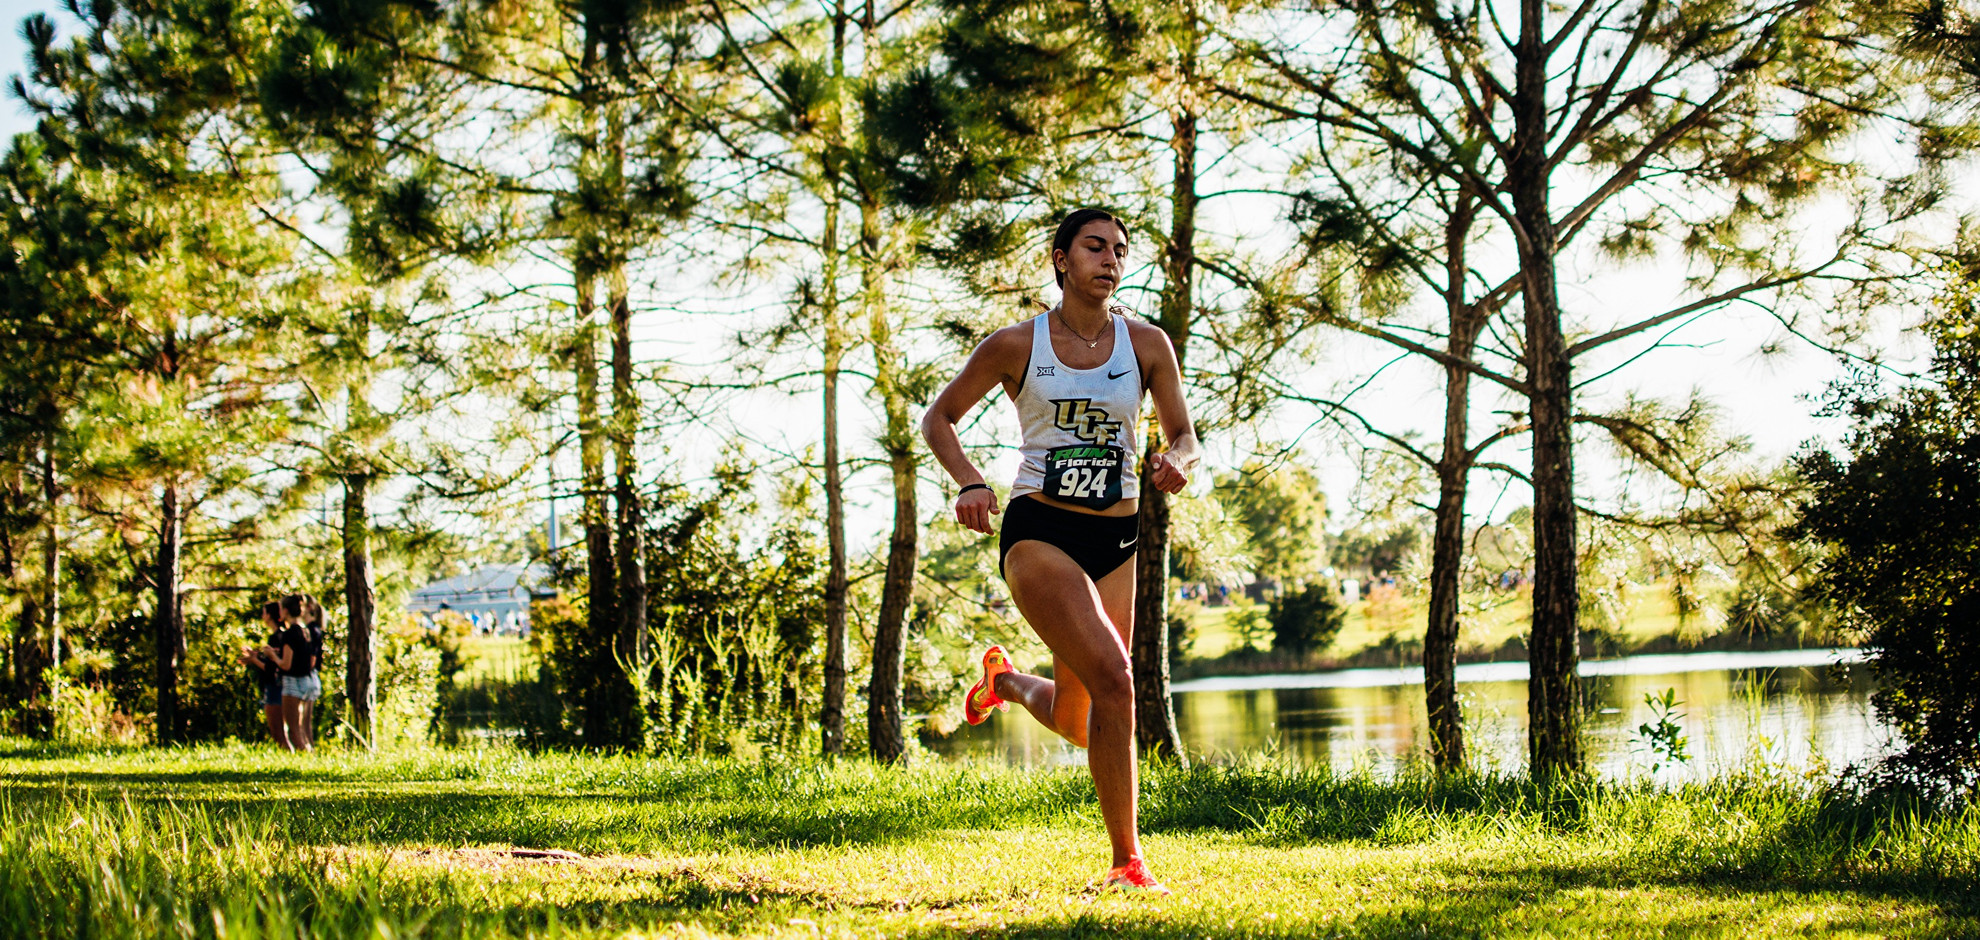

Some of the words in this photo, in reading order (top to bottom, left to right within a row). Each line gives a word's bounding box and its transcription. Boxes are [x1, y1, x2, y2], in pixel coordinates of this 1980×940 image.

[1048, 398, 1123, 446] UCF
[1053, 448, 1109, 460] RUN
[1055, 458, 1118, 469] Florida
[1058, 468, 1108, 498] 924
